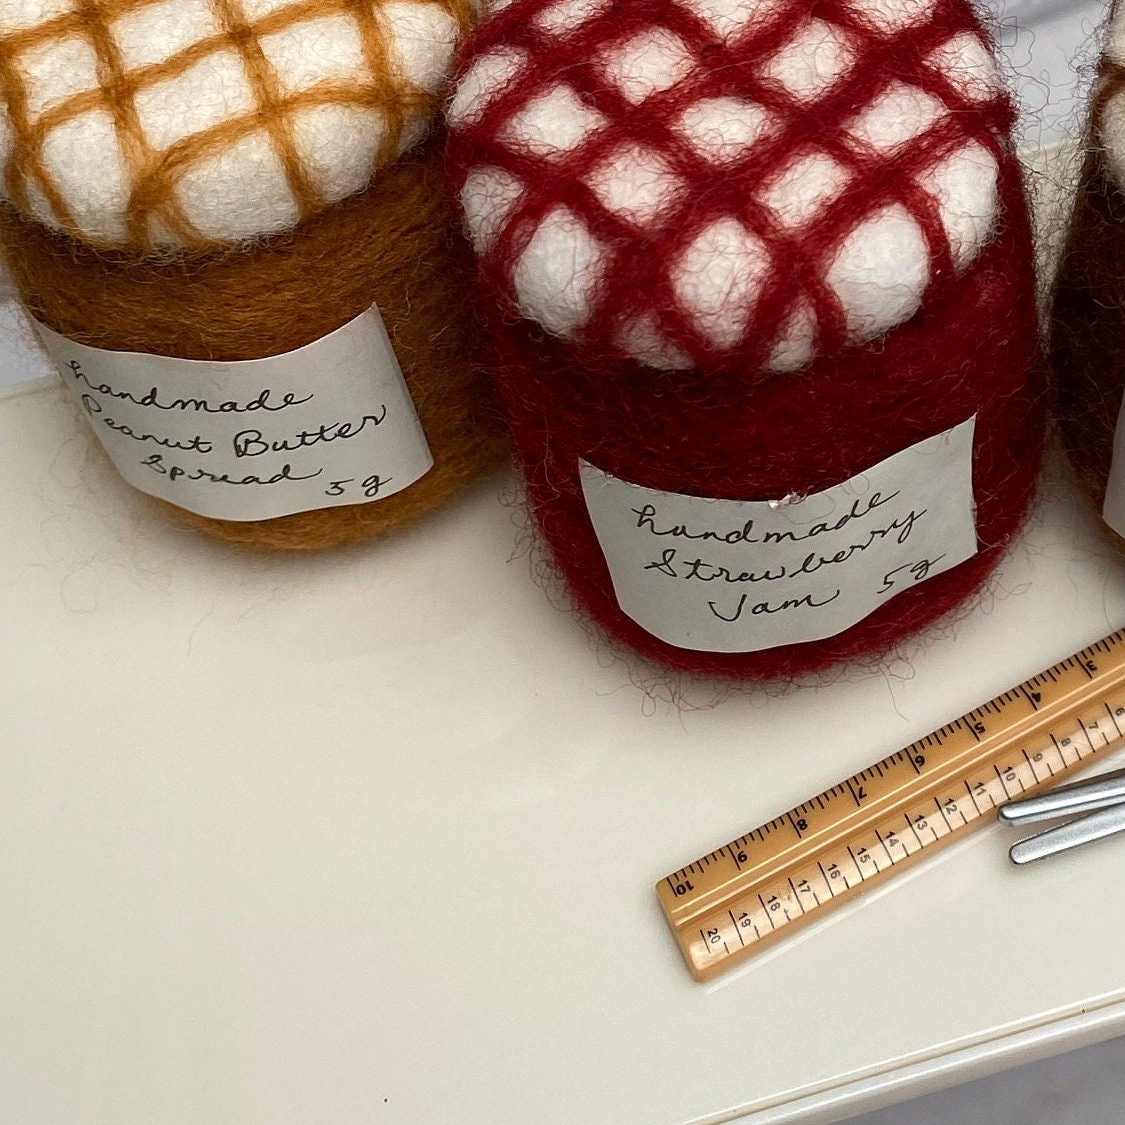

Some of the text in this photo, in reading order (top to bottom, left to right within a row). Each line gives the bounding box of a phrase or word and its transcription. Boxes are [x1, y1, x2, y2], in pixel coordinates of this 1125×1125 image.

[64, 360, 314, 413] handmade
[82, 394, 387, 457] Peanut Butter
[631, 490, 901, 544] handmade
[643, 508, 928, 583] Strawberry
[707, 588, 841, 622] Jam
[1086, 660, 1098, 672] 3
[1030, 691, 1042, 703] 4
[1115, 707, 1125, 717] 6
[973, 722, 986, 734] 5
[1088, 721, 1099, 730] 7
[1060, 737, 1072, 747] 8
[914, 755, 925, 767] 6
[1032, 752, 1044, 763] 9
[1002, 766, 1016, 782] 10
[857, 786, 868, 800] 7
[973, 781, 988, 798] 11
[944, 797, 958, 815] 12
[796, 818, 809, 831] 8
[914, 814, 928, 831] 13
[885, 830, 900, 848] 14
[736, 850, 748, 863] 9
[856, 846, 872, 864] 15
[827, 863, 841, 880] 16
[676, 880, 695, 896] 10
[797, 879, 811, 894] 17
[766, 895, 781, 912] 18
[738, 912, 752, 928] 19
[707, 927, 721, 944] 20
